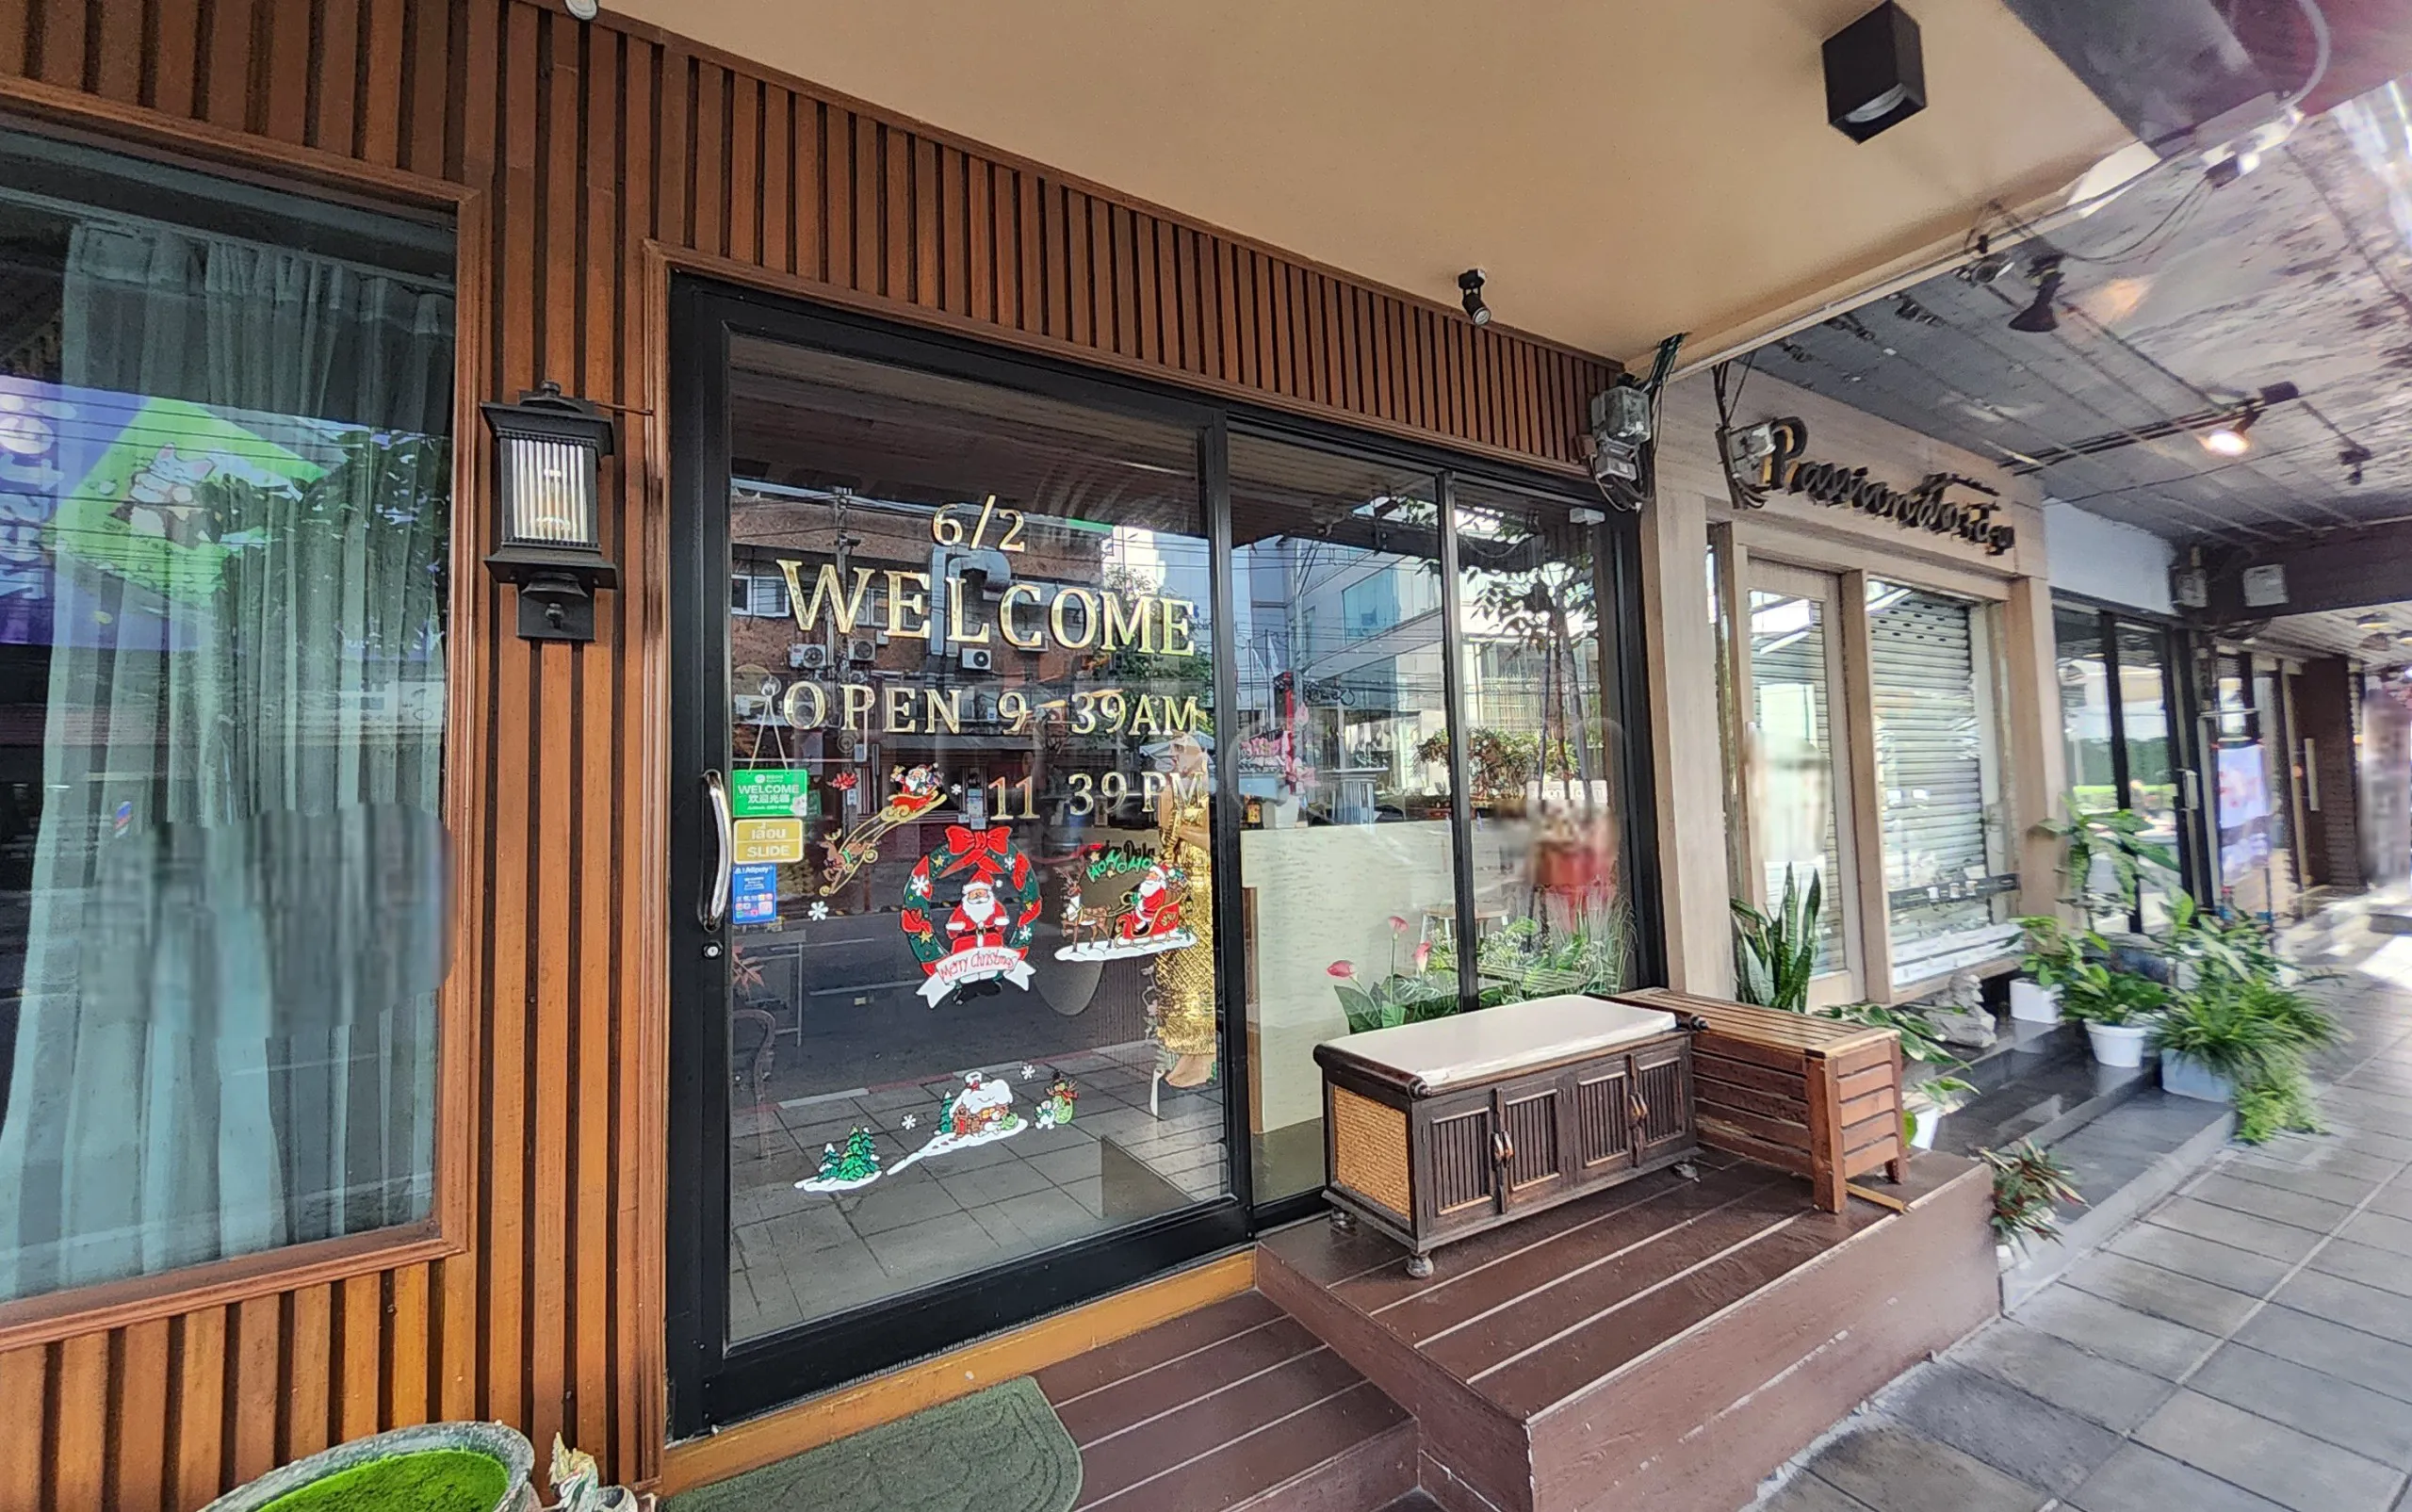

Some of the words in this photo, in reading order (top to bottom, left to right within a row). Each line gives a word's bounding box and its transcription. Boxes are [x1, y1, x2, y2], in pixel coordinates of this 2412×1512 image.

[932, 495, 1026, 553] 6/2
[775, 559, 1195, 657] WELCOME
[782, 681, 963, 735] OPEN
[738, 784, 800, 794] WELCOME
[988, 775, 1040, 821] 11
[751, 821, 787, 840] เลื่อน
[747, 845, 790, 857] SLIDE
[940, 956, 969, 978] Merry
[970, 949, 1016, 969] Christmas
